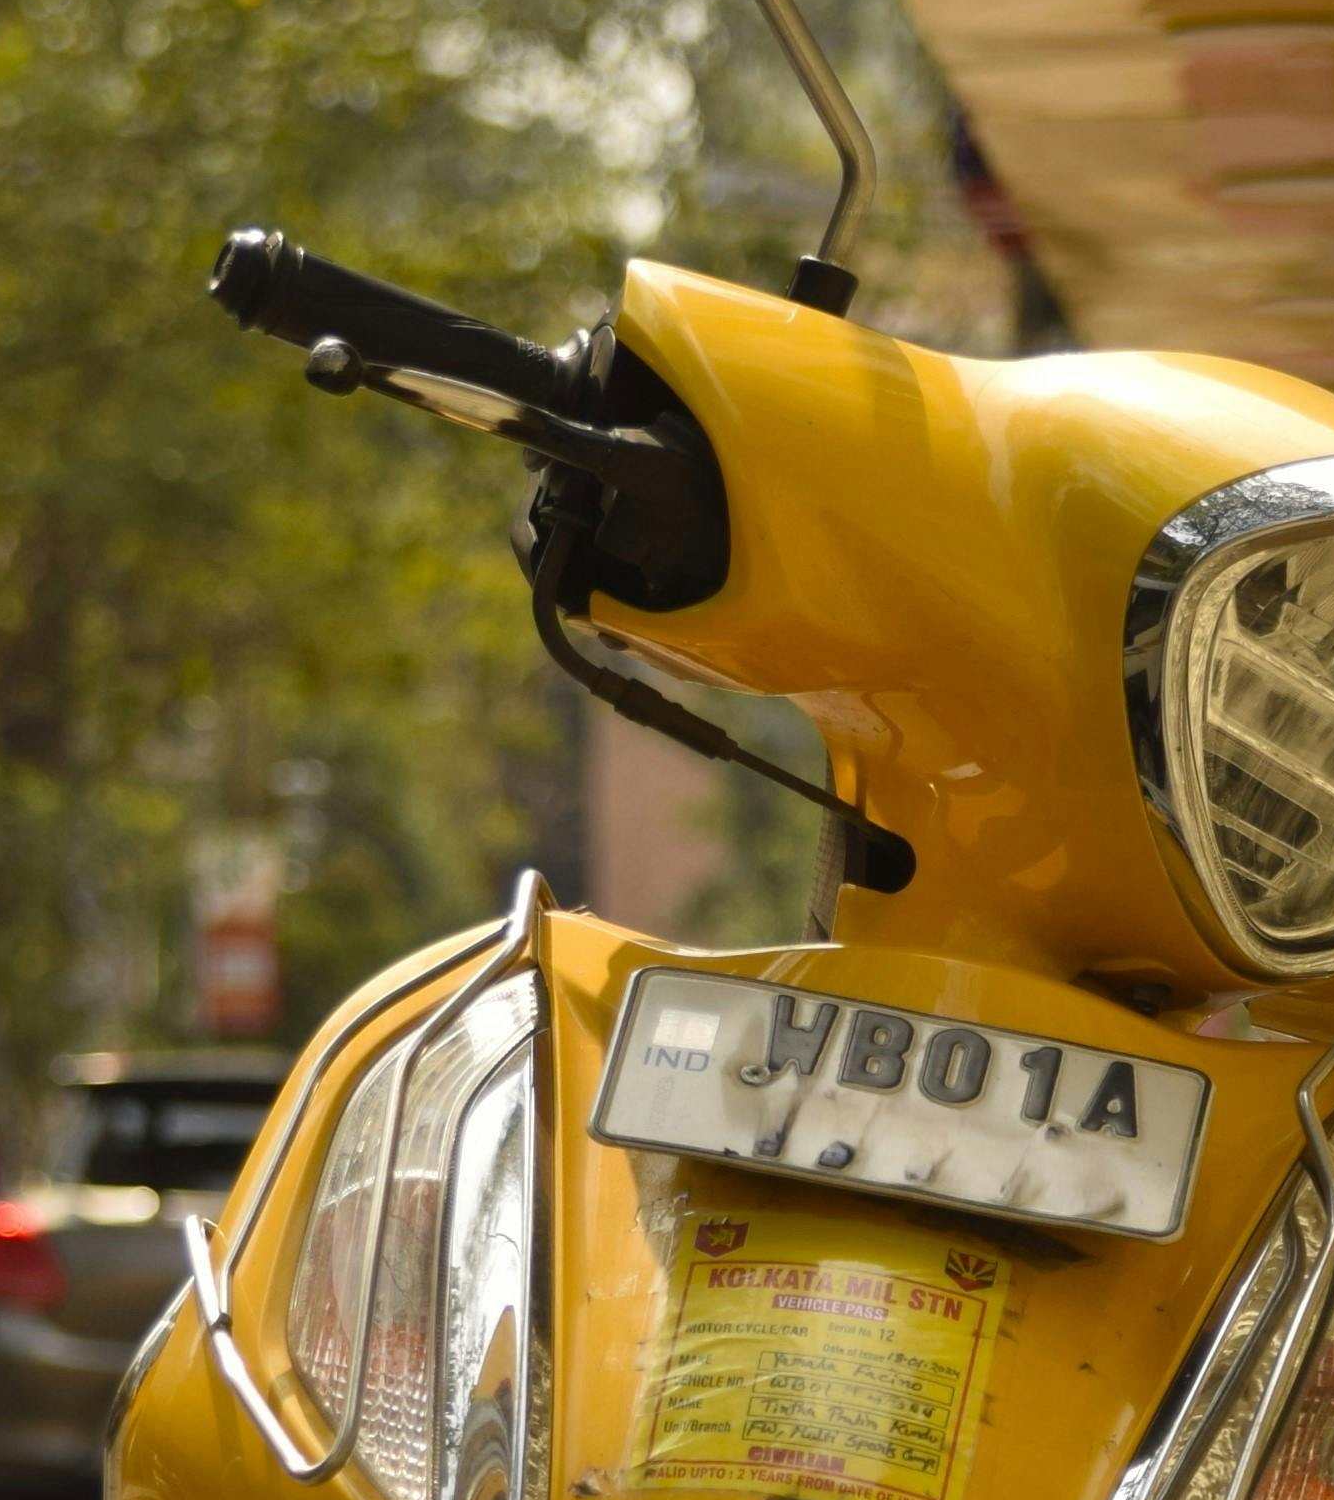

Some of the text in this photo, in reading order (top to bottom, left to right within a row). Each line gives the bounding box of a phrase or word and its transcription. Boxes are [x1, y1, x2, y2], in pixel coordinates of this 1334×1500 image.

[642, 1047, 710, 1072] IND
[707, 1267, 964, 1321] KOLKATA MIL STN
[777, 1295, 886, 1321] VEHICLE PASS
[685, 1322, 809, 1338] MOTOR CYCLE/CAR
[879, 1328, 896, 1344] 12
[690, 1467, 726, 1480] UPTO
[736, 1468, 746, 1481] 2
[749, 1469, 793, 1486] YEARS
[797, 1475, 836, 1492] FROM
[838, 1480, 873, 1500] DATE
